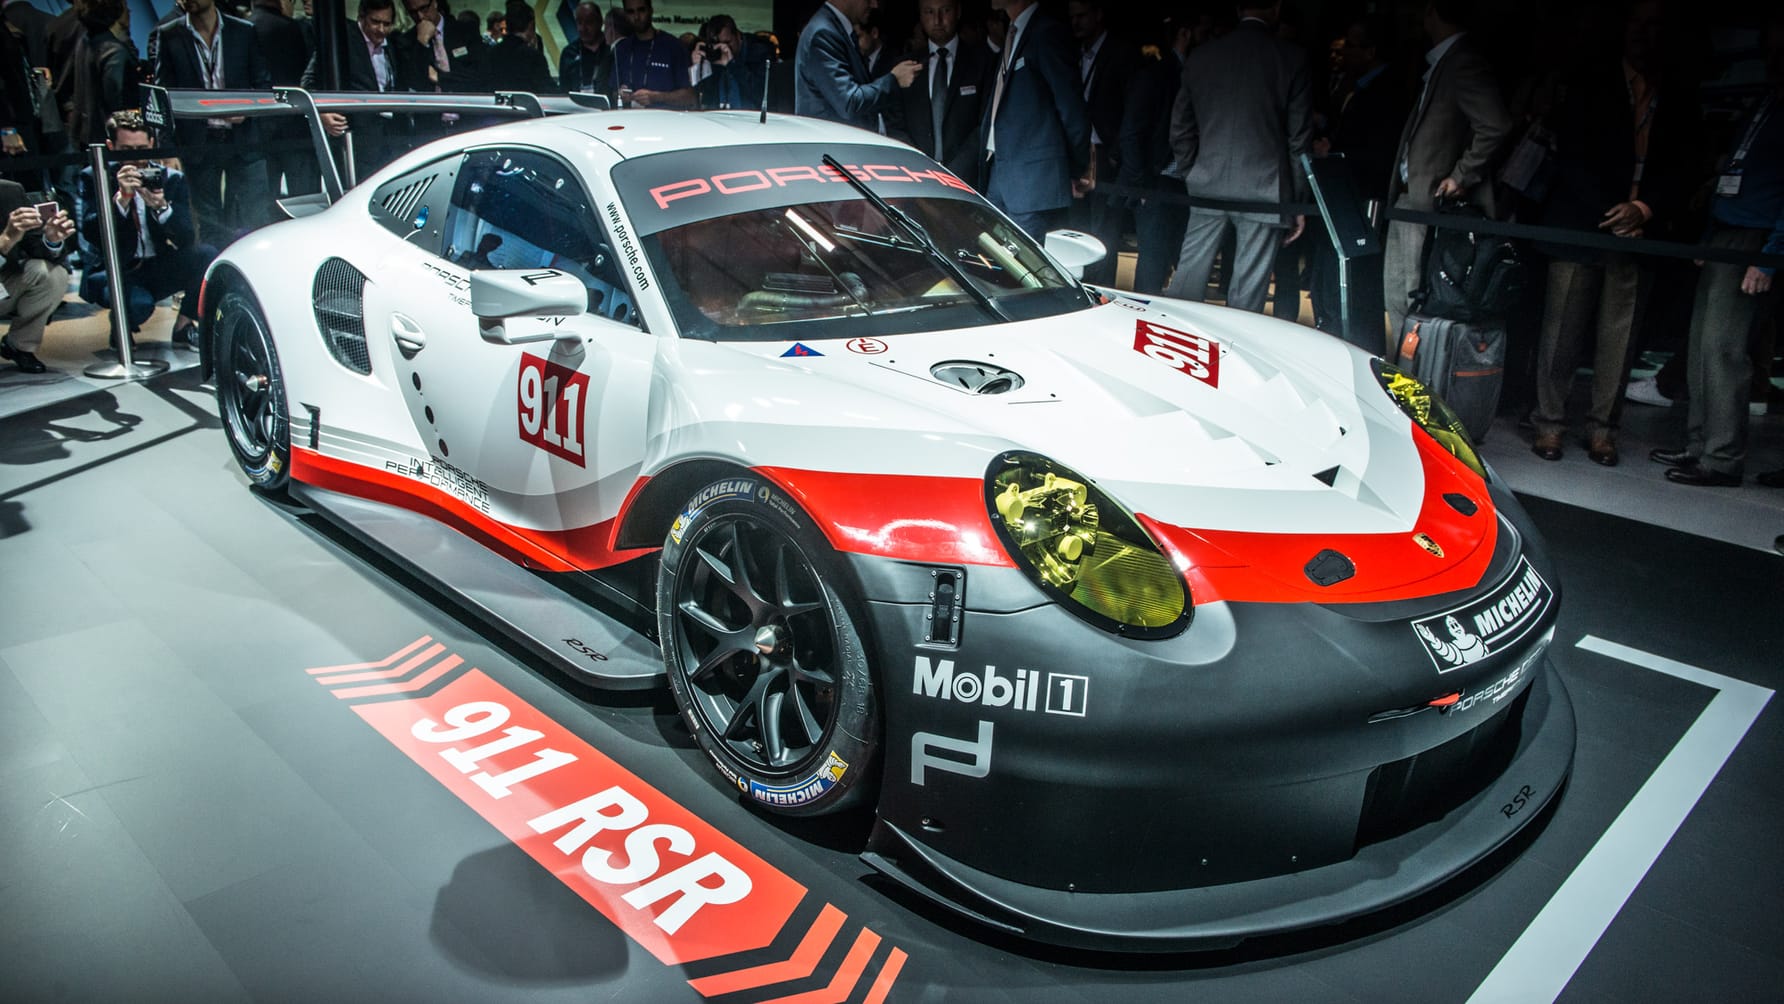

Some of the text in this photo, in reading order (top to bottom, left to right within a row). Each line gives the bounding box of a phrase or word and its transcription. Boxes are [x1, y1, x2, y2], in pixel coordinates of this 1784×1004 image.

[649, 164, 977, 210] PORSCHE
[606, 201, 650, 291] www.porsche.com
[1143, 323, 1210, 379] 911
[520, 365, 583, 456] 911
[385, 460, 491, 513] PERFORMANCE
[409, 457, 489, 502] INTELLIGENT
[431, 455, 489, 493] PORSCHE
[687, 481, 754, 513] MICHELIN
[1473, 566, 1542, 638] MICHELIN
[561, 638, 609, 662] RSR
[912, 655, 1040, 712] Mobil
[1449, 666, 1521, 717] PORSCHE
[754, 780, 825, 805] MICHELIN
[1500, 784, 1537, 819] RSR
[411, 701, 753, 936] 911 RSR
